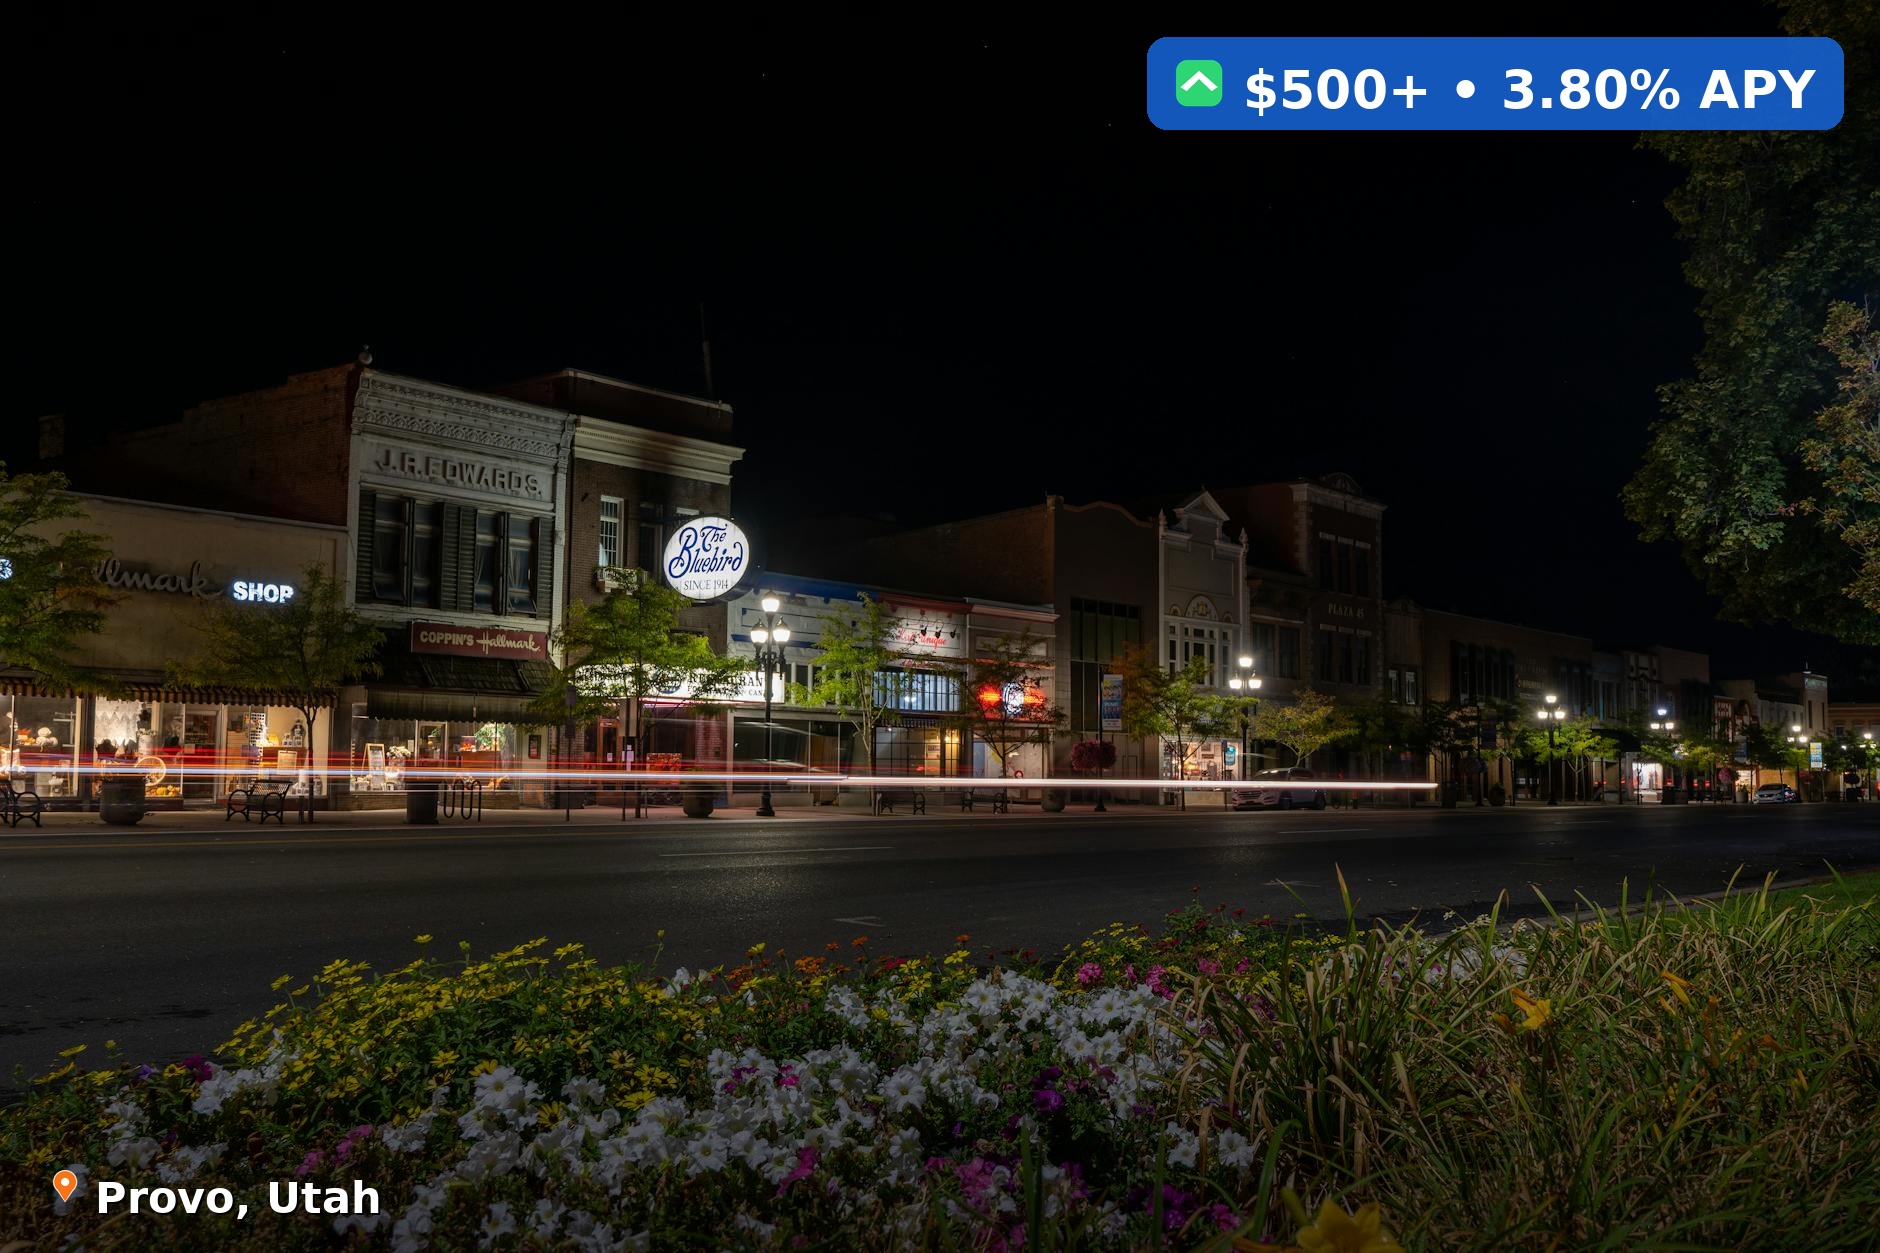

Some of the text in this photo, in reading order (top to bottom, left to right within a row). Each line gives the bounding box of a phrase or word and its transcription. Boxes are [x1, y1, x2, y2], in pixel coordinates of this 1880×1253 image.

[700, 523, 728, 553] The
[668, 526, 744, 579] Bluebird
[233, 581, 294, 604] SHOP
[684, 579, 729, 591] SINCE 1914
[1328, 602, 1354, 617] PLAZA
[419, 630, 541, 656] COPPIN'S Hallmark
